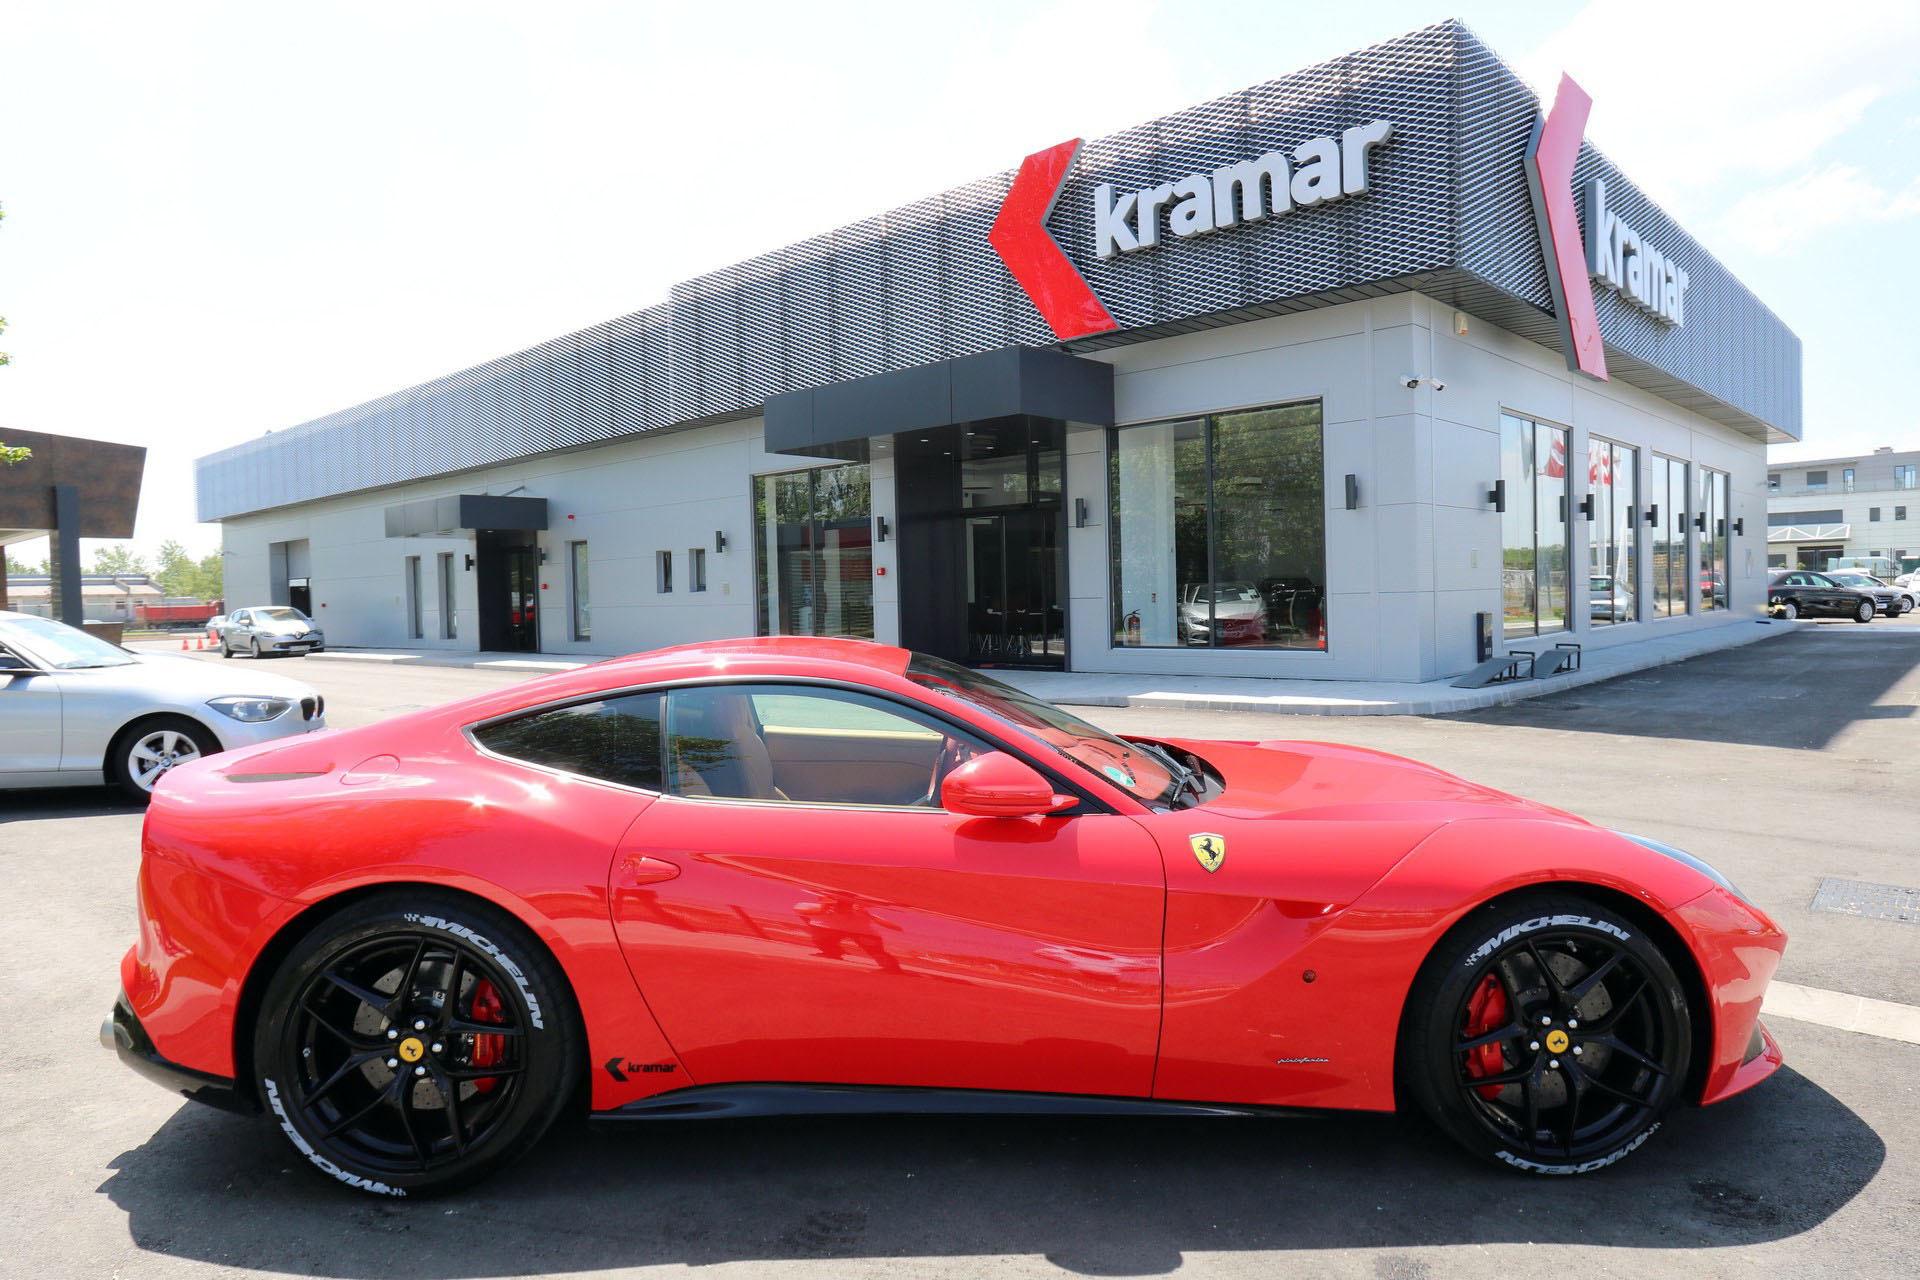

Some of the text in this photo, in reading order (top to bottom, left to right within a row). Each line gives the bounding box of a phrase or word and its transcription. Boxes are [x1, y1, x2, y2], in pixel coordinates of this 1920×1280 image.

[1095, 119, 1394, 259] kramar
[1585, 178, 1689, 329] kramar
[420, 915, 543, 1030] MICHELIN
[1476, 914, 1631, 956] MICHELIN
[627, 1062, 677, 1073] kramar
[264, 1078, 391, 1194] MICHELIN
[1495, 1132, 1650, 1174] MICHELIN
